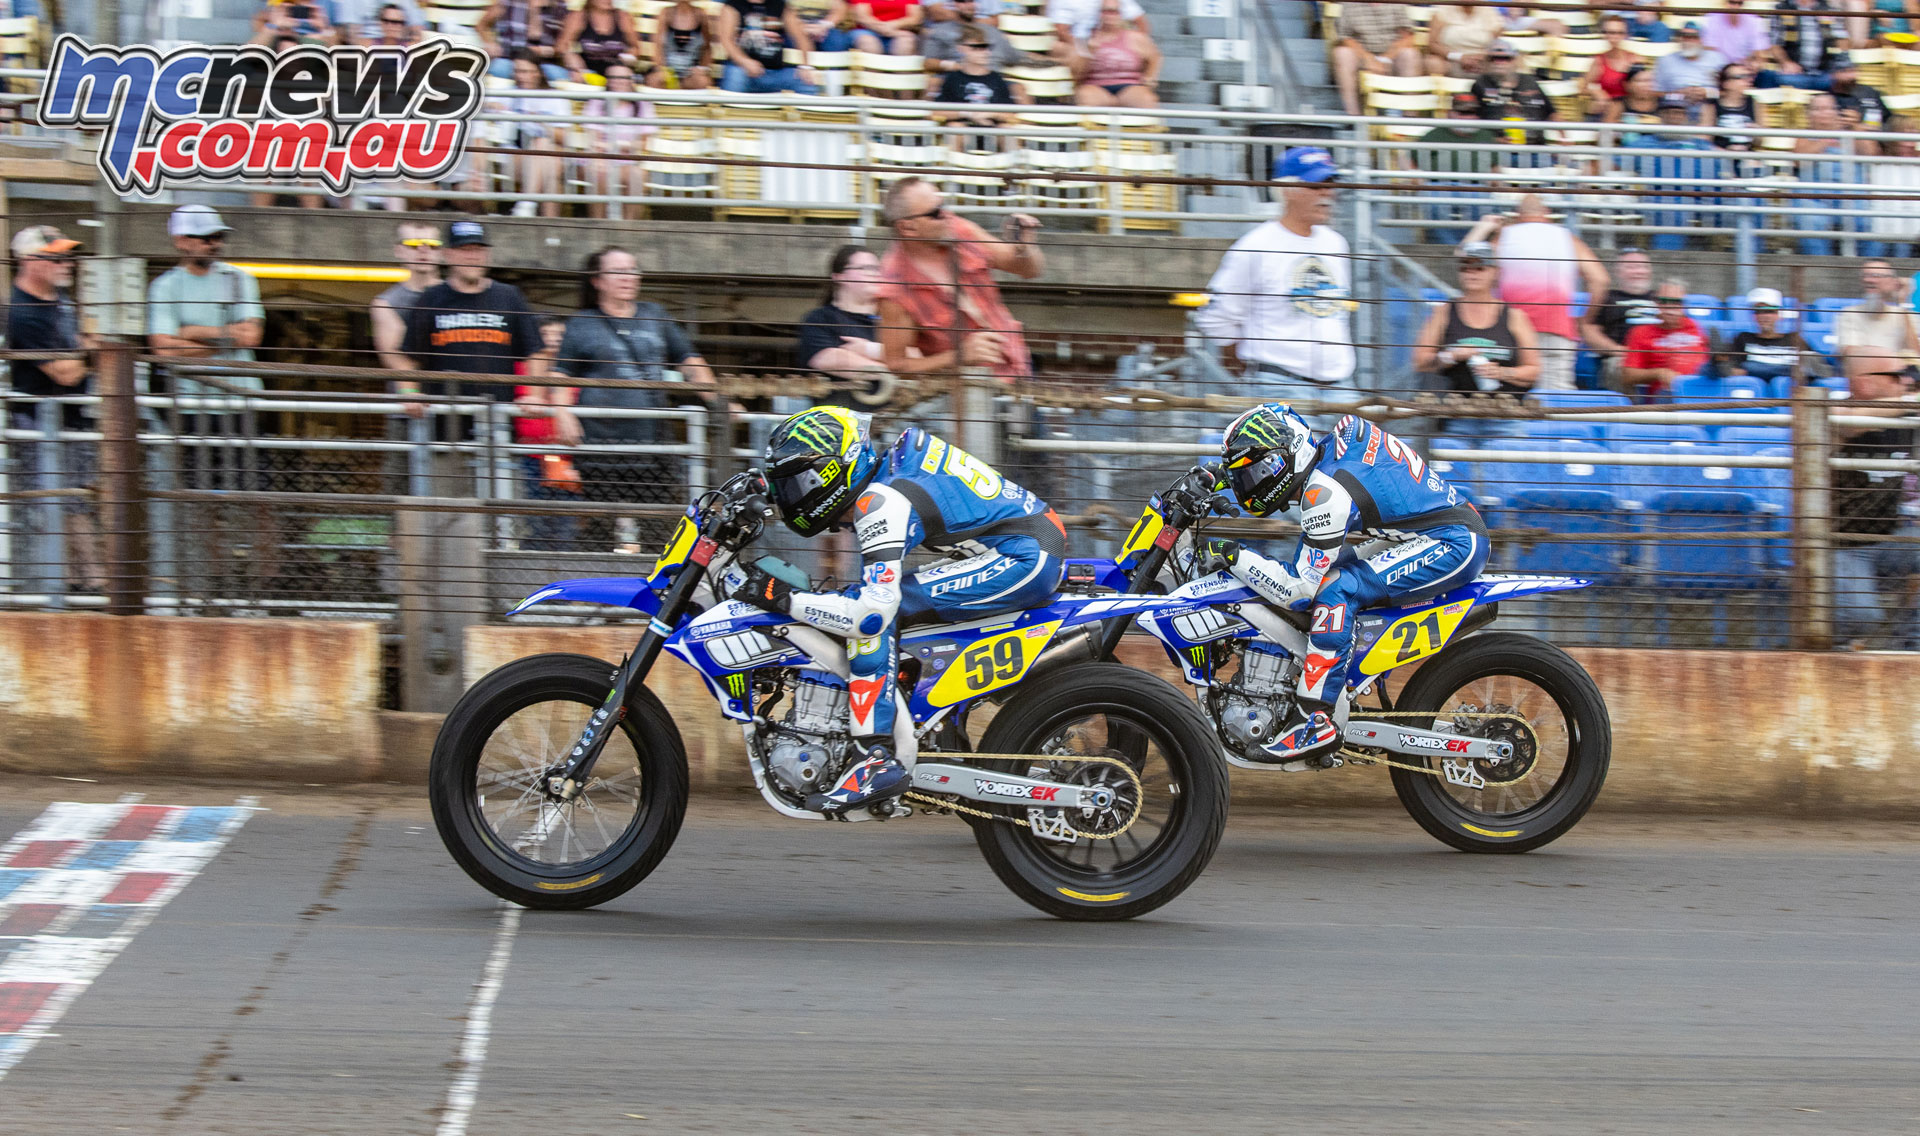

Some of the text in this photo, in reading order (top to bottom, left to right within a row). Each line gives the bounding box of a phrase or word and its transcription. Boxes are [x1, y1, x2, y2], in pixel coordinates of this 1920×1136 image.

[1262, 472, 1294, 503] MONSTER
[930, 556, 1018, 598] DAINESE
[1386, 543, 1453, 586] DAINESE
[804, 606, 854, 625] ESTENSON
[1311, 604, 1346, 634] 21
[1392, 612, 1442, 664] 21
[964, 635, 1024, 691] 59
[1398, 733, 1472, 753] VORTEX EK
[974, 779, 1061, 801] VORTEX EK
